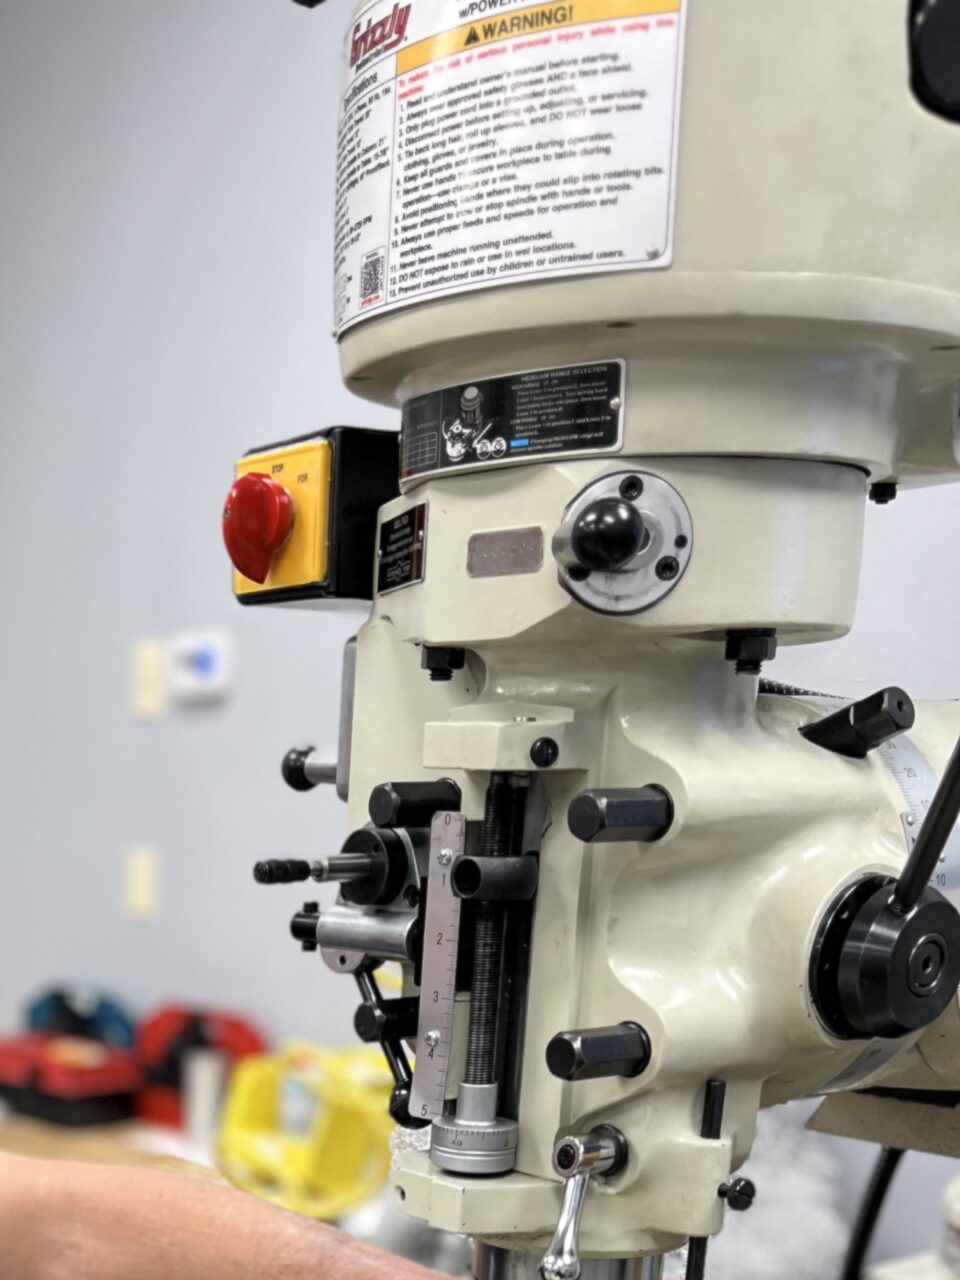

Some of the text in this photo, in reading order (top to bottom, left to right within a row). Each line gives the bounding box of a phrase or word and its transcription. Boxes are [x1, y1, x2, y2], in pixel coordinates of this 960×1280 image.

[482, 5, 573, 39] WARNING!
[513, 35, 551, 53] personal
[591, 27, 616, 36] while
[623, 22, 649, 33] using
[657, 19, 675, 28] this
[514, 62, 546, 76] manual
[549, 58, 578, 70] before
[582, 52, 620, 65] starting.
[447, 91, 481, 108] approved
[484, 85, 507, 97] safety
[548, 72, 568, 83] AND
[579, 68, 598, 77] face
[602, 63, 632, 74] shield.
[465, 115, 489, 126] before
[588, 95, 598, 103] or
[601, 88, 648, 100] servicing.
[479, 101, 494, 110] into
[432, 139, 446, 149] long
[466, 129, 478, 139] roll
[481, 128, 491, 136] up
[530, 114, 546, 125] and
[590, 107, 613, 115] wear
[616, 103, 642, 112] loose
[429, 163, 453, 177] guards
[500, 148, 507, 156] in
[509, 144, 533, 157] place
[535, 139, 565, 151] during
[568, 131, 616, 145] operation.
[496, 154, 540, 170] workpiece
[543, 153, 552, 162] to
[555, 149, 577, 160] table
[580, 145, 611, 157] during
[481, 178, 490, 186] or
[486, 186, 511, 198] where
[514, 184, 532, 194] they
[535, 179, 560, 190] could
[563, 174, 579, 186] slip
[582, 172, 600, 182] into
[604, 167, 641, 180] rotating
[645, 165, 665, 176] bits.
[447, 211, 453, 219] to
[475, 205, 483, 213] or
[486, 201, 504, 212] stop
[506, 194, 538, 207] spindle
[541, 191, 559, 201] with
[562, 186, 591, 198] hands
[594, 186, 604, 194] or
[607, 181, 633, 192] tools.
[424, 230, 435, 239] use
[437, 223, 460, 238] proper
[463, 218, 483, 229] feeds
[486, 214, 500, 224] and
[504, 209, 534, 221] speeds
[537, 205, 550, 215] for
[552, 200, 597, 213] operation
[600, 196, 618, 206] and
[425, 262, 449, 276] expose
[451, 260, 458, 269] to
[461, 257, 475, 268] rain
[477, 255, 485, 263] or
[488, 253, 502, 261] use
[505, 250, 512, 258] in
[515, 247, 530, 257] wet
[533, 241, 577, 255] locations.
[437, 247, 467, 262] machine
[469, 239, 500, 252] running
[503, 229, 554, 246] unattended.
[471, 268, 485, 278] use
[487, 264, 497, 275] by
[499, 257, 534, 272] children
[537, 256, 546, 266] or
[548, 252, 593, 265] untrained
[596, 250, 626, 260] users.
[444, 812, 452, 826] 0
[936, 873, 946, 887] 10
[436, 932, 443, 946] 2
[432, 990, 439, 1004] 3
[420, 1104, 427, 1117] 5
